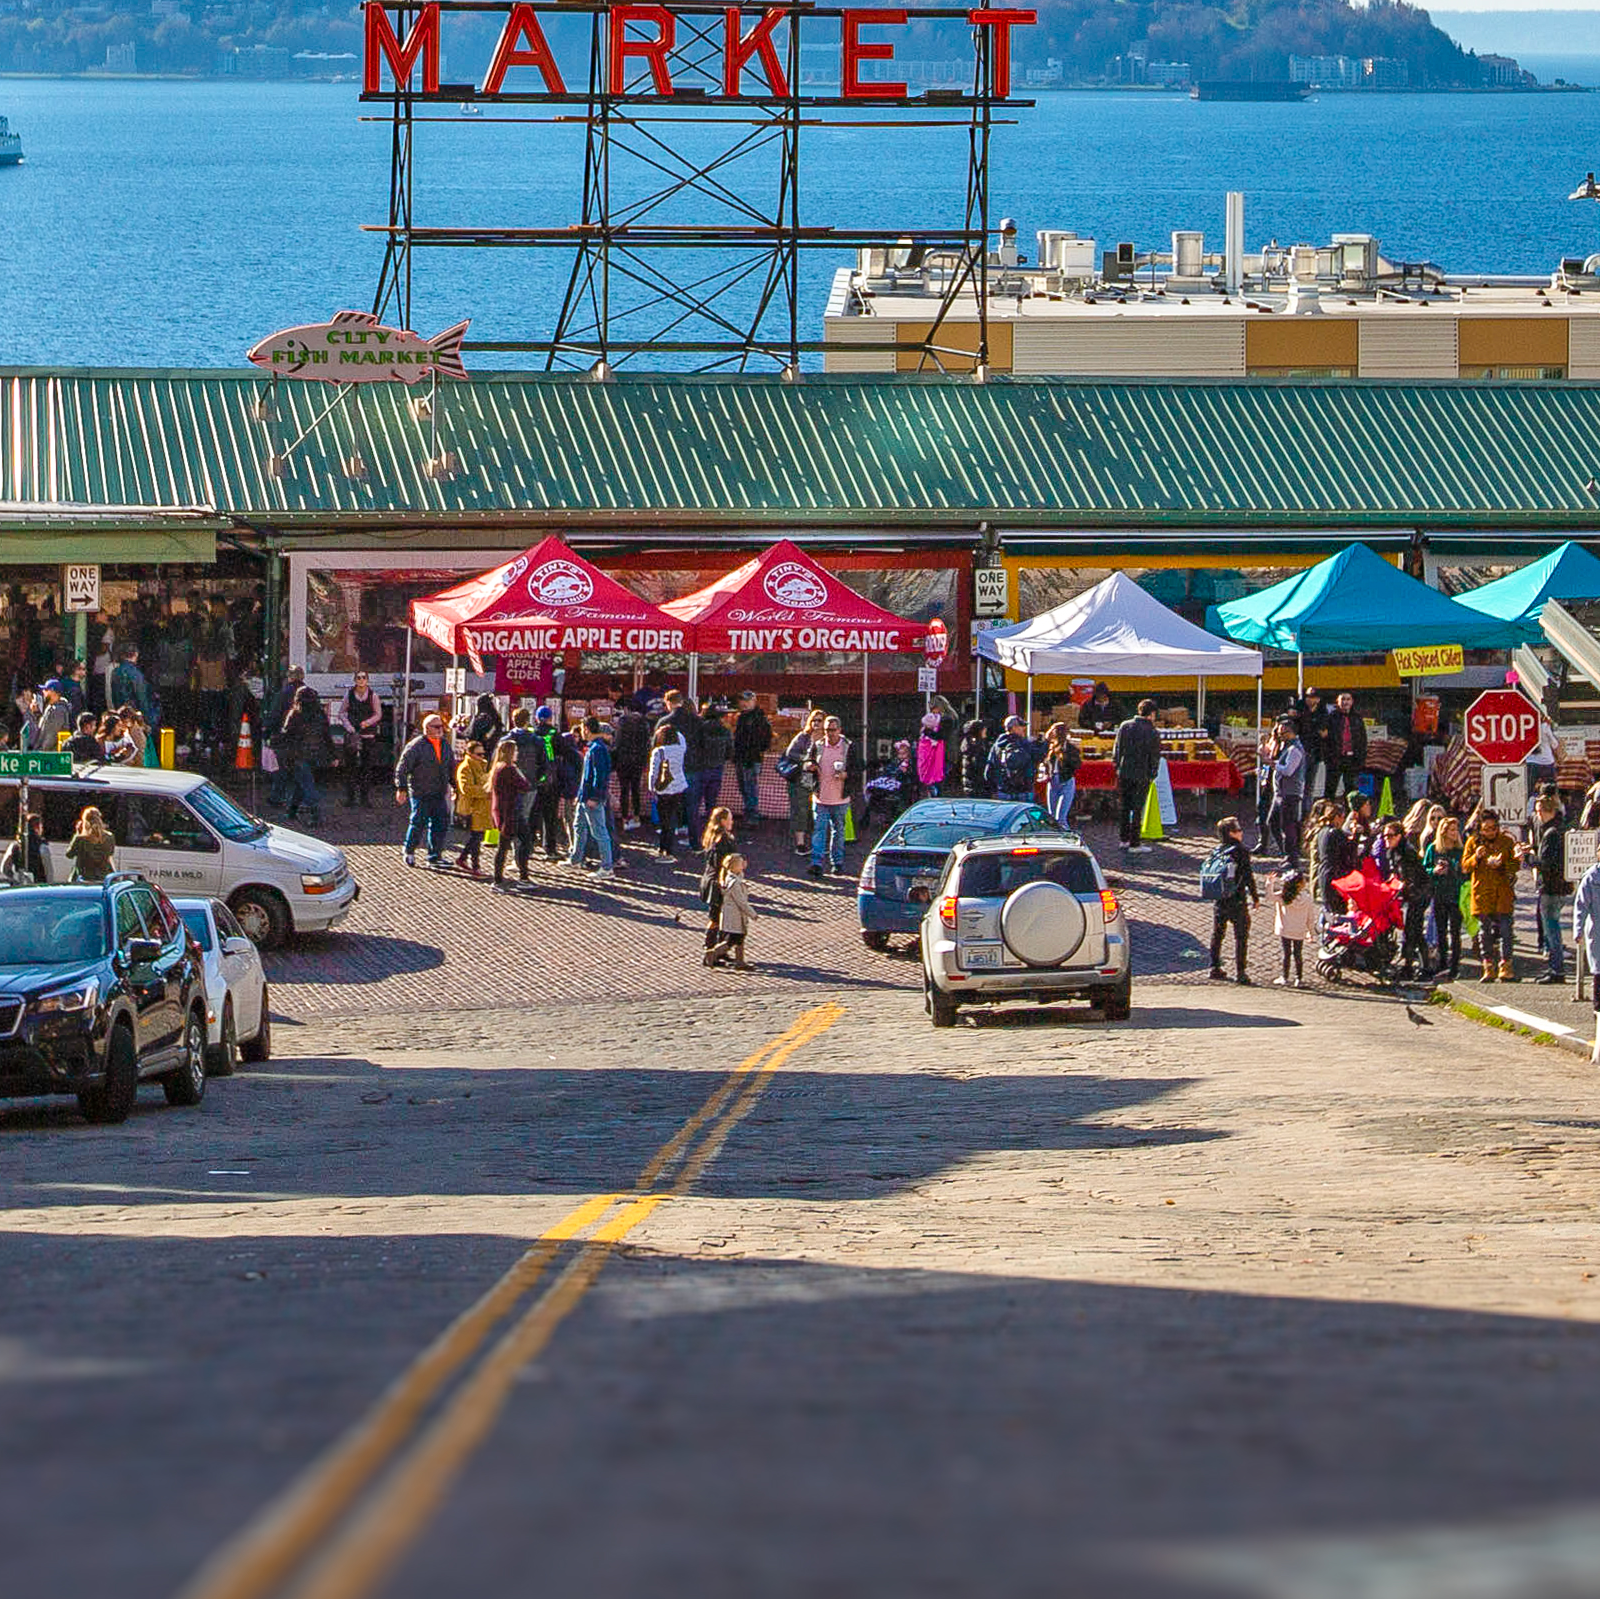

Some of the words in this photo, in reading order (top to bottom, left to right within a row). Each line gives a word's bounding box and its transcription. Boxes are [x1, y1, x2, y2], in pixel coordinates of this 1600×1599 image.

[362, 1, 1040, 99] MARKET
[326, 330, 392, 345] CITY
[272, 349, 329, 365] FISH
[339, 350, 445, 365] MARKET
[70, 567, 96, 579] ONE
[536, 561, 583, 577] TINY'S
[772, 564, 814, 583] TINY'S
[978, 572, 1004, 584] ONE
[70, 581, 96, 592] WAY
[978, 585, 1004, 596] WAY
[539, 592, 587, 605] ORGANIC
[775, 595, 822, 608] ORGANIC
[564, 605, 648, 620] Famous
[727, 607, 796, 622] World
[801, 609, 883, 624] Famous
[472, 629, 558, 651] ORGANIC
[560, 627, 623, 650] APPLE
[625, 628, 685, 650] CIDER
[727, 628, 793, 650] TINY'S
[797, 628, 899, 650] ORGANIC
[506, 659, 542, 670] APPLE
[1395, 652, 1414, 670] Hot
[506, 669, 542, 680] CIDER
[1470, 713, 1536, 743] STOP
[28, 759, 42, 772] Pl
[1494, 807, 1523, 821] NLY
[1570, 837, 1594, 846] POLICE
[149, 869, 173, 878] FARM
